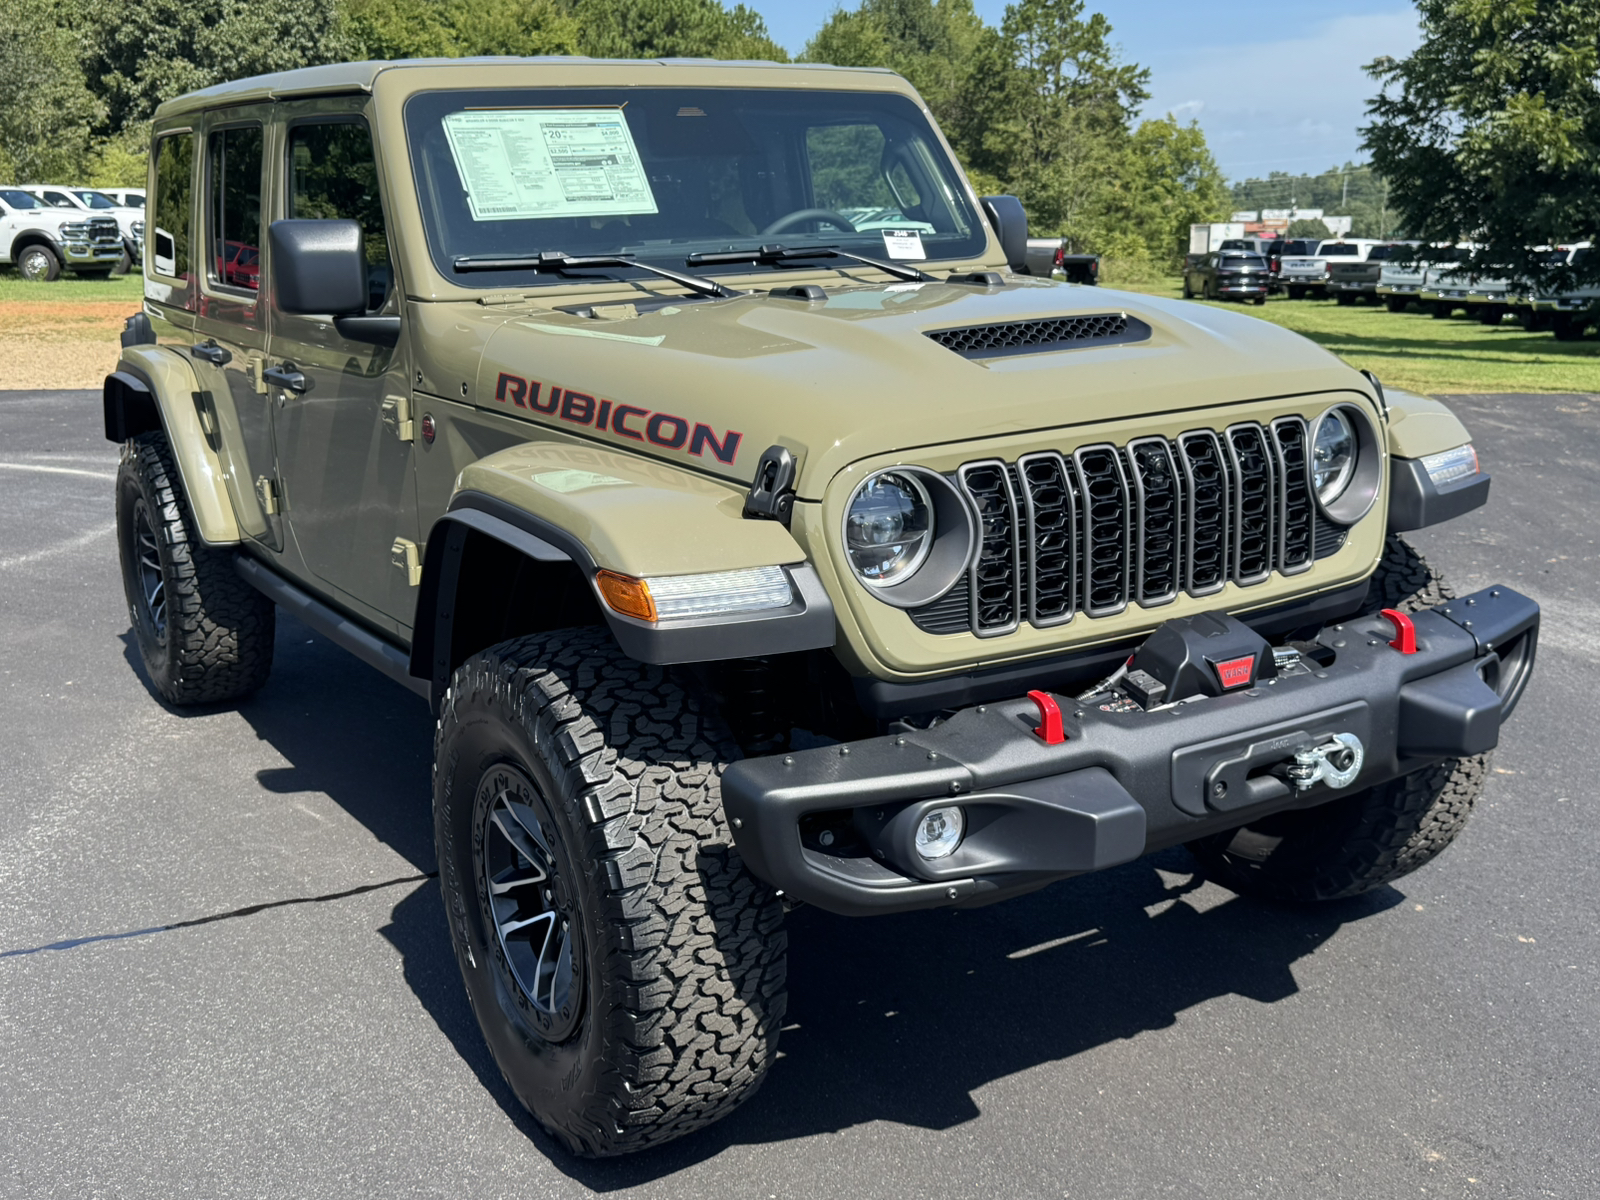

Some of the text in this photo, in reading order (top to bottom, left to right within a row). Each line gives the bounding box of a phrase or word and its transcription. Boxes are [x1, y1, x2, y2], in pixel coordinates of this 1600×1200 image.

[548, 130, 561, 139] 20
[495, 372, 743, 466] RUBICON
[1224, 666, 1249, 680] WARN
